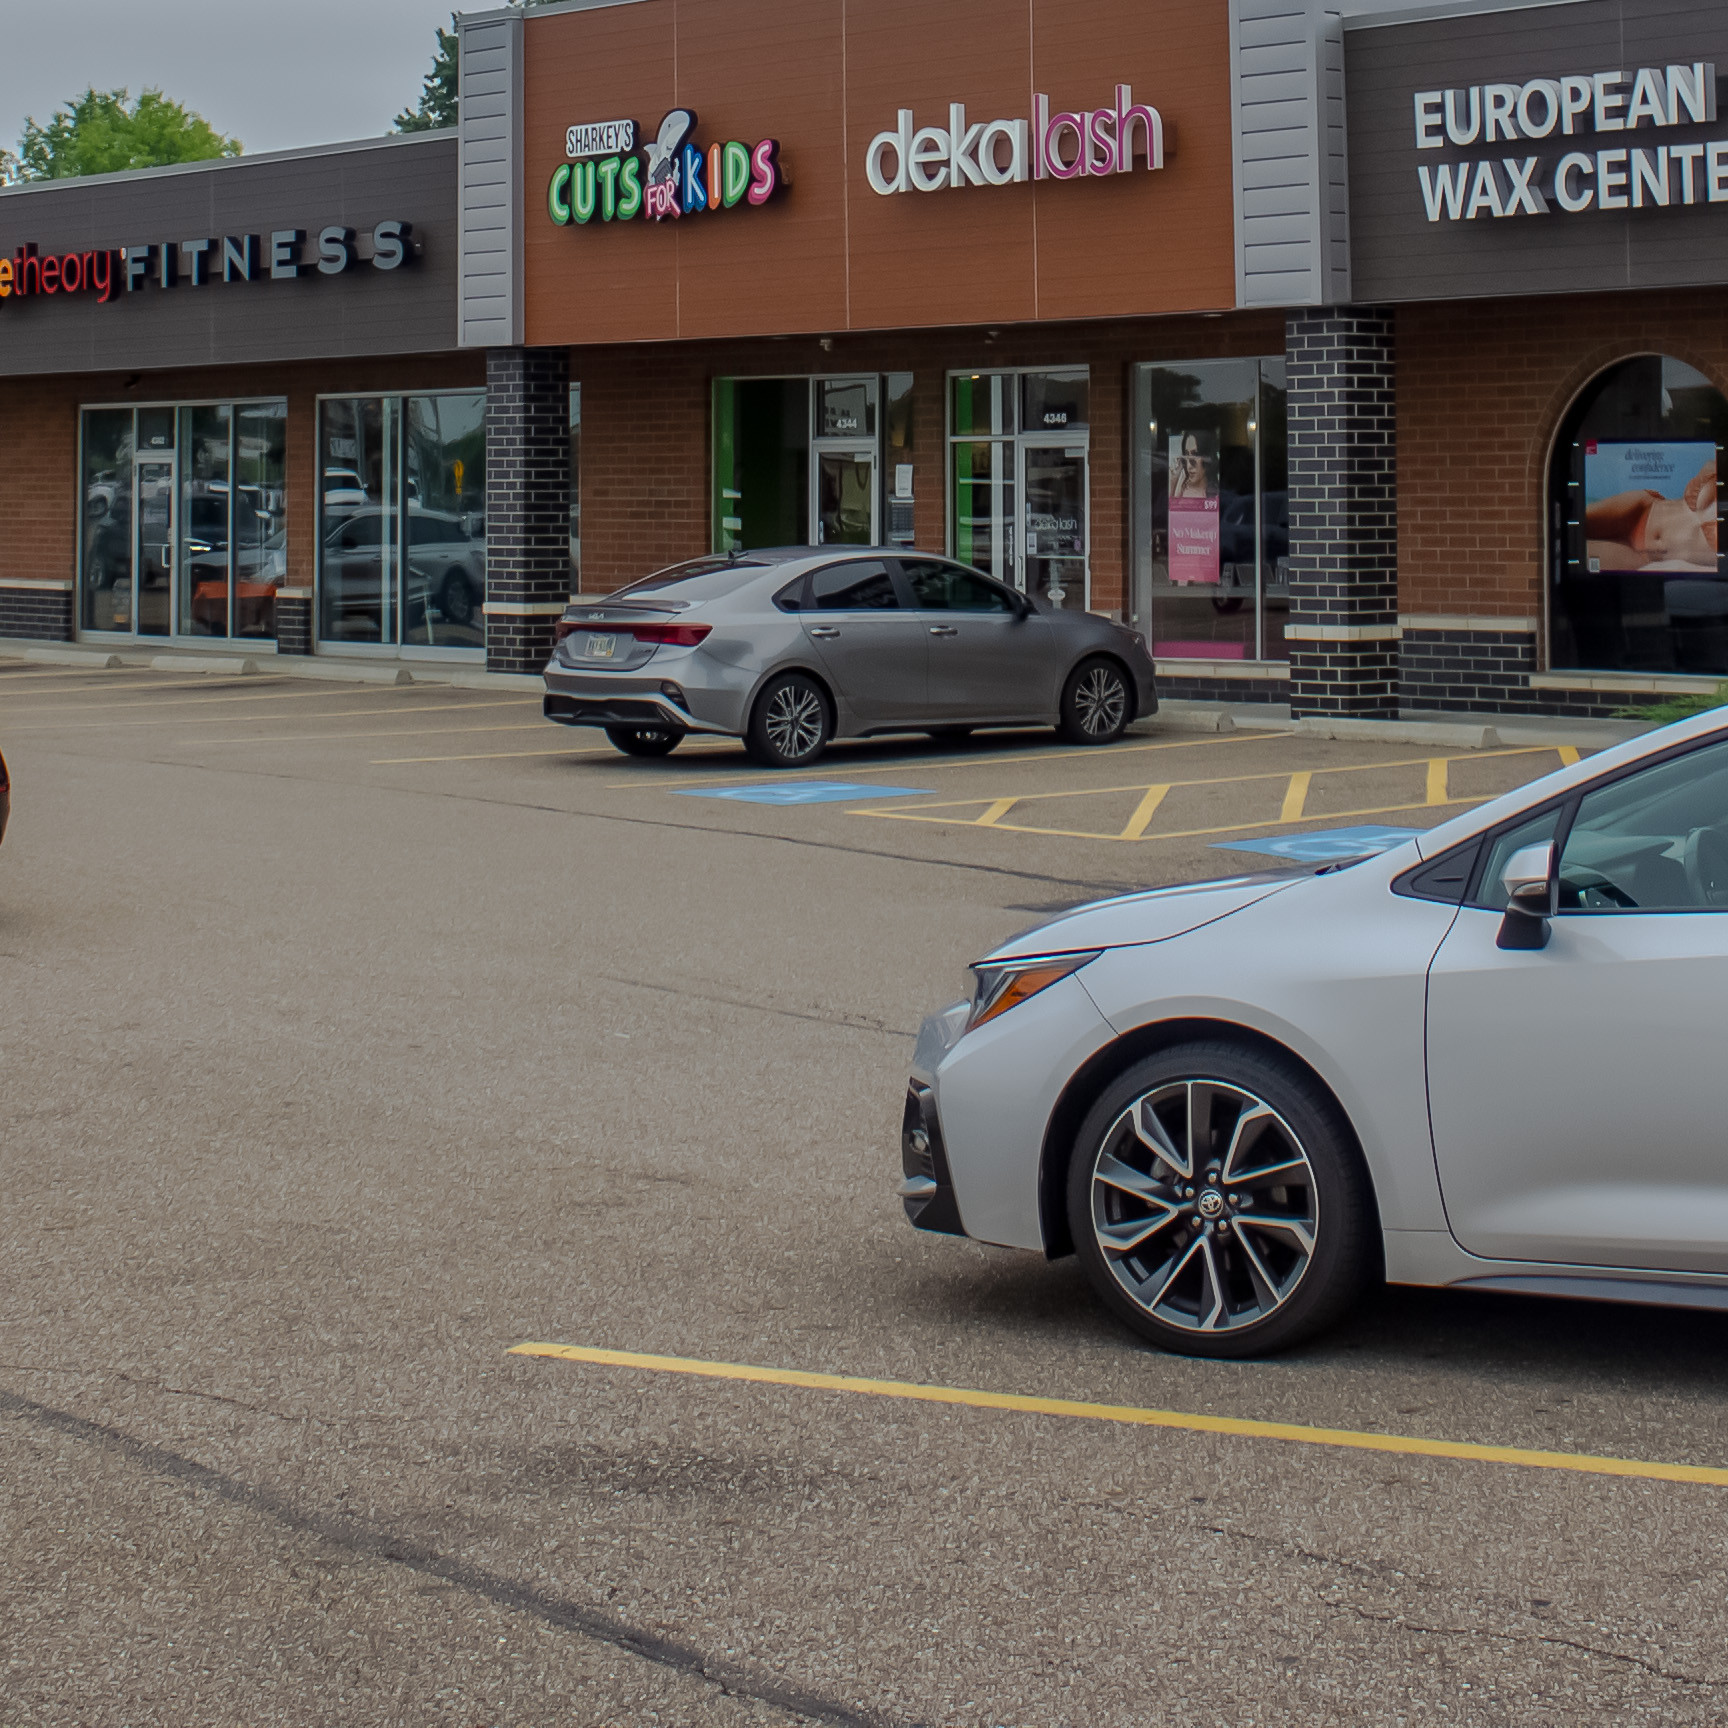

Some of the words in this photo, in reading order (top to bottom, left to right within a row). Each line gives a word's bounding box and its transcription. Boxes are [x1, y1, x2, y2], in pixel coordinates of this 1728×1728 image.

[567, 120, 633, 156] SHARKEY'S
[1414, 62, 1717, 149] EUROPEAN
[549, 156, 642, 226] CUTS
[646, 179, 681, 218] FOR
[682, 139, 775, 214] KIDS
[1418, 156, 1548, 222] WAX
[127, 220, 409, 292] FITNESS
